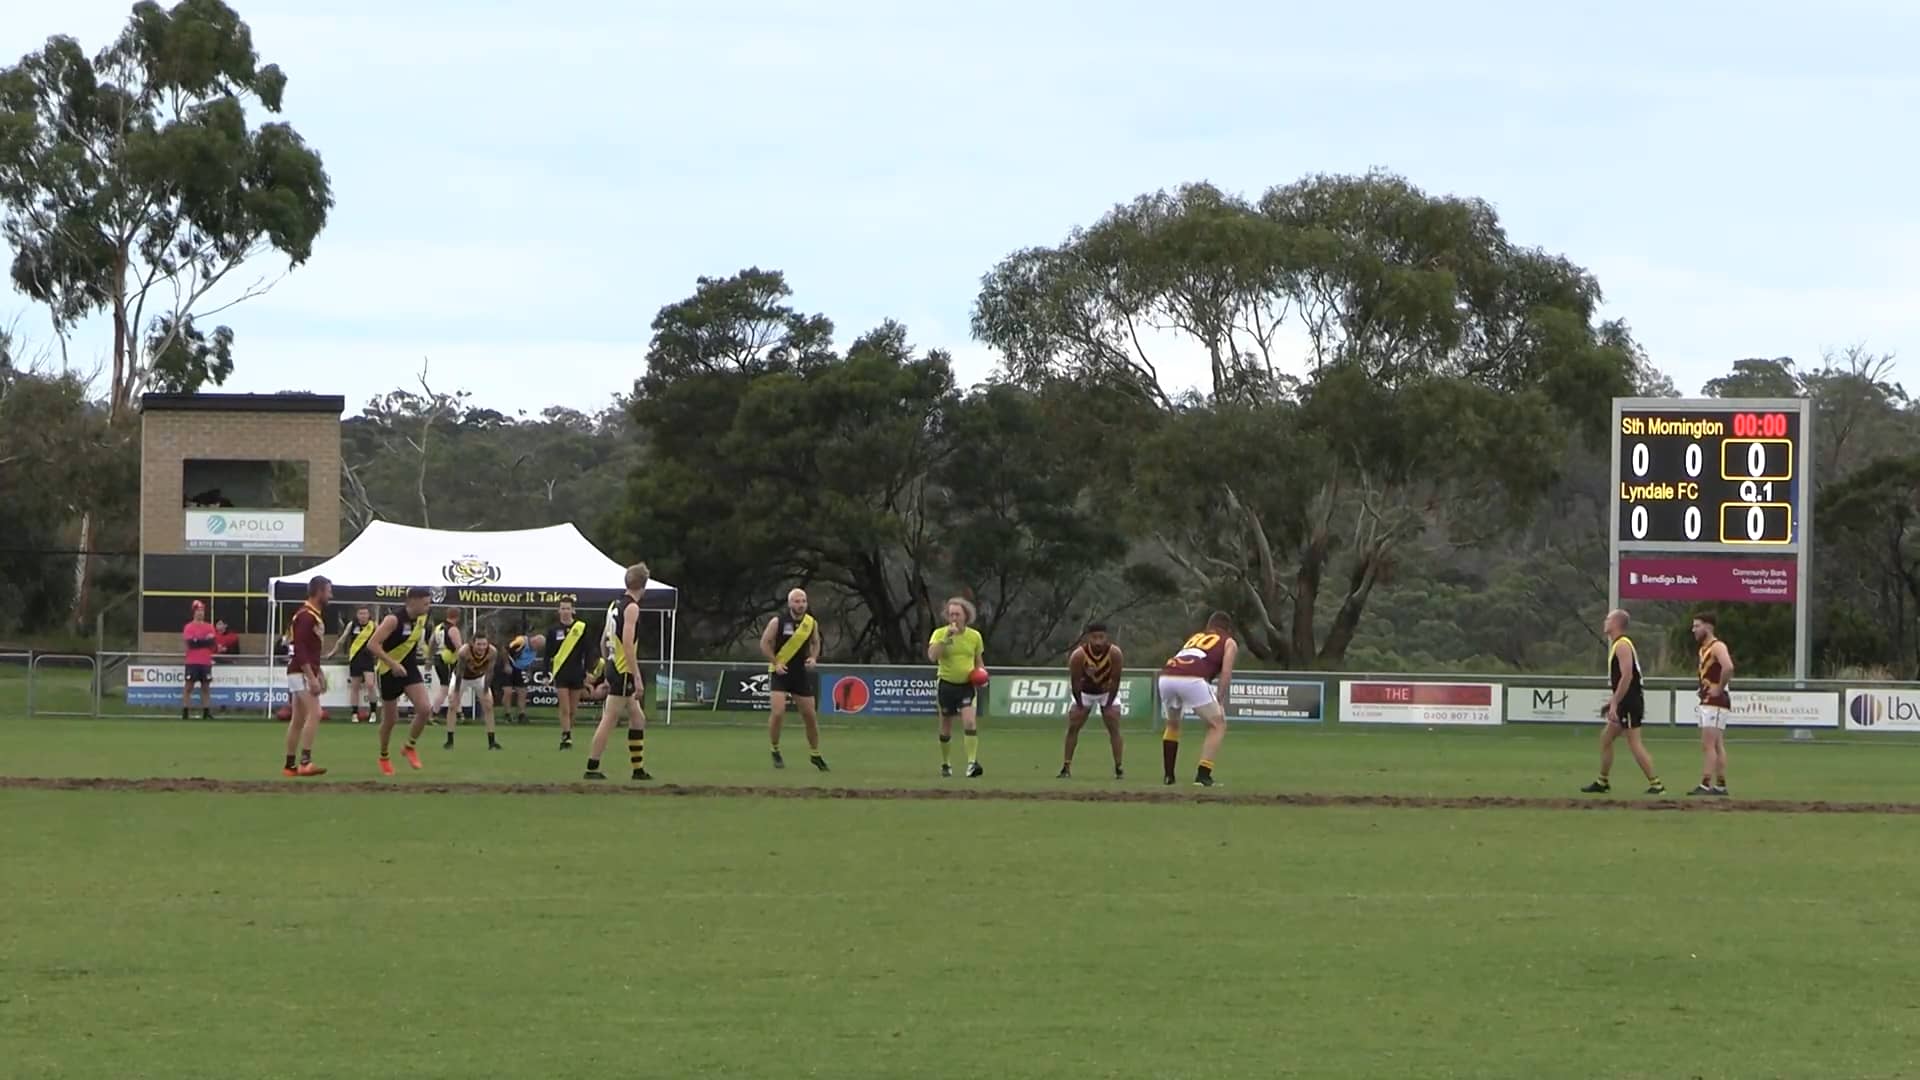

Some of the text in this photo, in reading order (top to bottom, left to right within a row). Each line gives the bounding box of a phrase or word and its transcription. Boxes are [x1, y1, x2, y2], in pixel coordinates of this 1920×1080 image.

[1622, 418, 1724, 439] Sth Mornington
[1734, 413, 1787, 437] 00:00
[1632, 442, 1703, 477] 0 0
[1747, 442, 1766, 478] 0
[1621, 482, 1699, 503] Lyndale FC
[1739, 480, 1773, 503] Q.1
[229, 519, 284, 532] APOLLO
[1631, 505, 1702, 540] 0 0
[1747, 505, 1765, 541] 0
[1642, 574, 1698, 586] Bendigo Bank
[1770, 569, 1788, 577] Bank
[458, 589, 523, 604] Whatever
[146, 668, 186, 683] Choic
[873, 679, 937, 688] COAST 2 COAST
[1246, 685, 1289, 696] SECURITY
[234, 691, 261, 703] 5975
[873, 688, 904, 697] CARPET
[1384, 687, 1409, 700] THE
